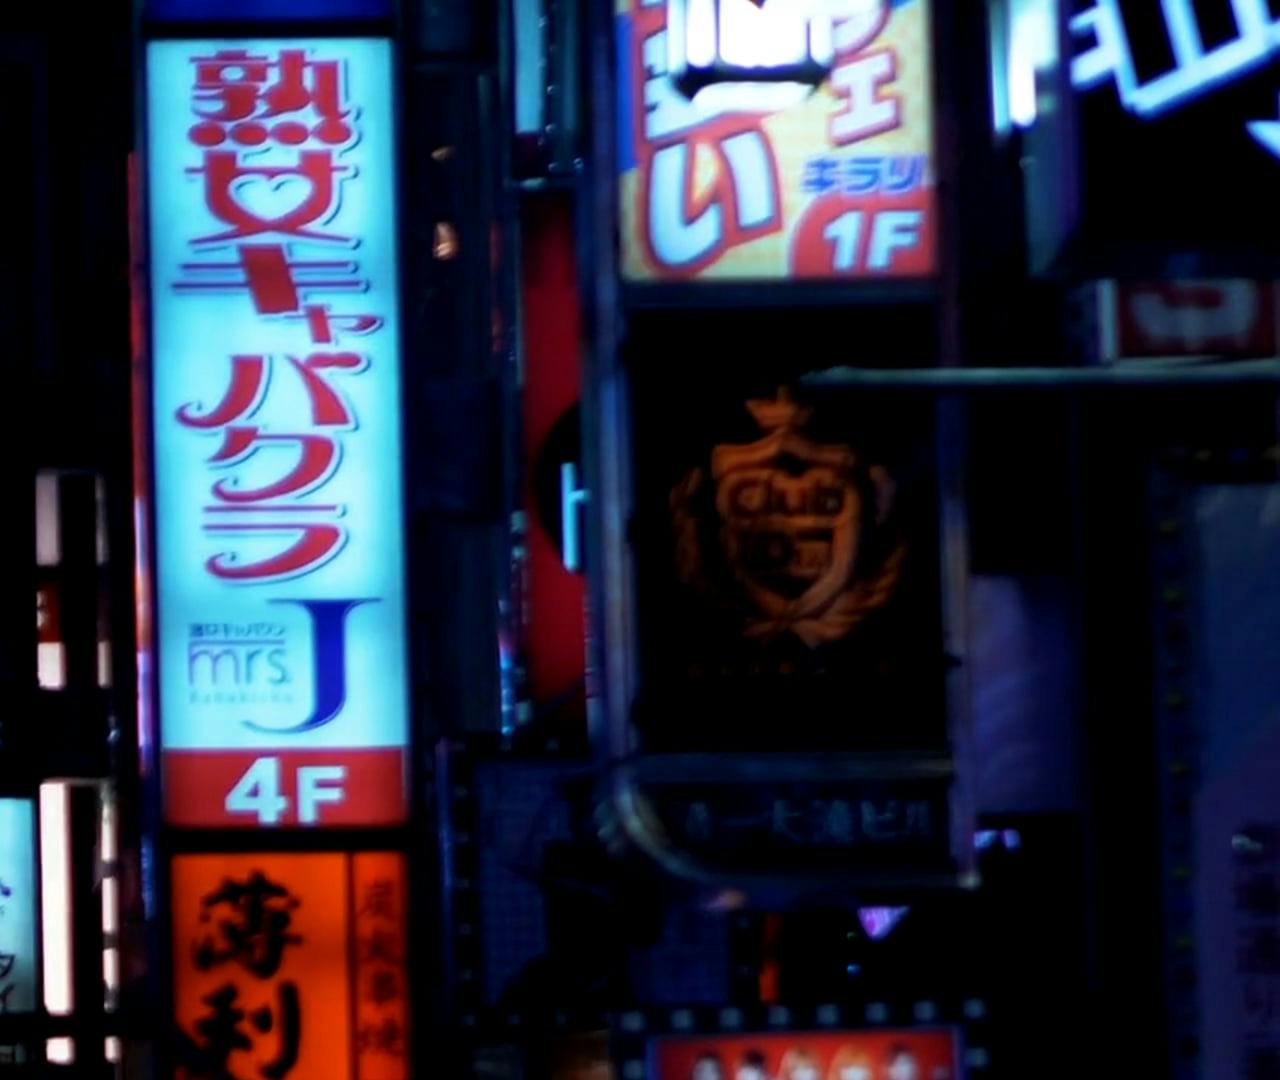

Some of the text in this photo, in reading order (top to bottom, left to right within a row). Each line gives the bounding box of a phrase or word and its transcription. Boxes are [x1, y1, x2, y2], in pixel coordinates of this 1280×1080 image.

[802, 155, 926, 193] キラリ
[823, 210, 923, 270] 1F
[242, 597, 382, 734] J
[224, 757, 350, 824] 4F
